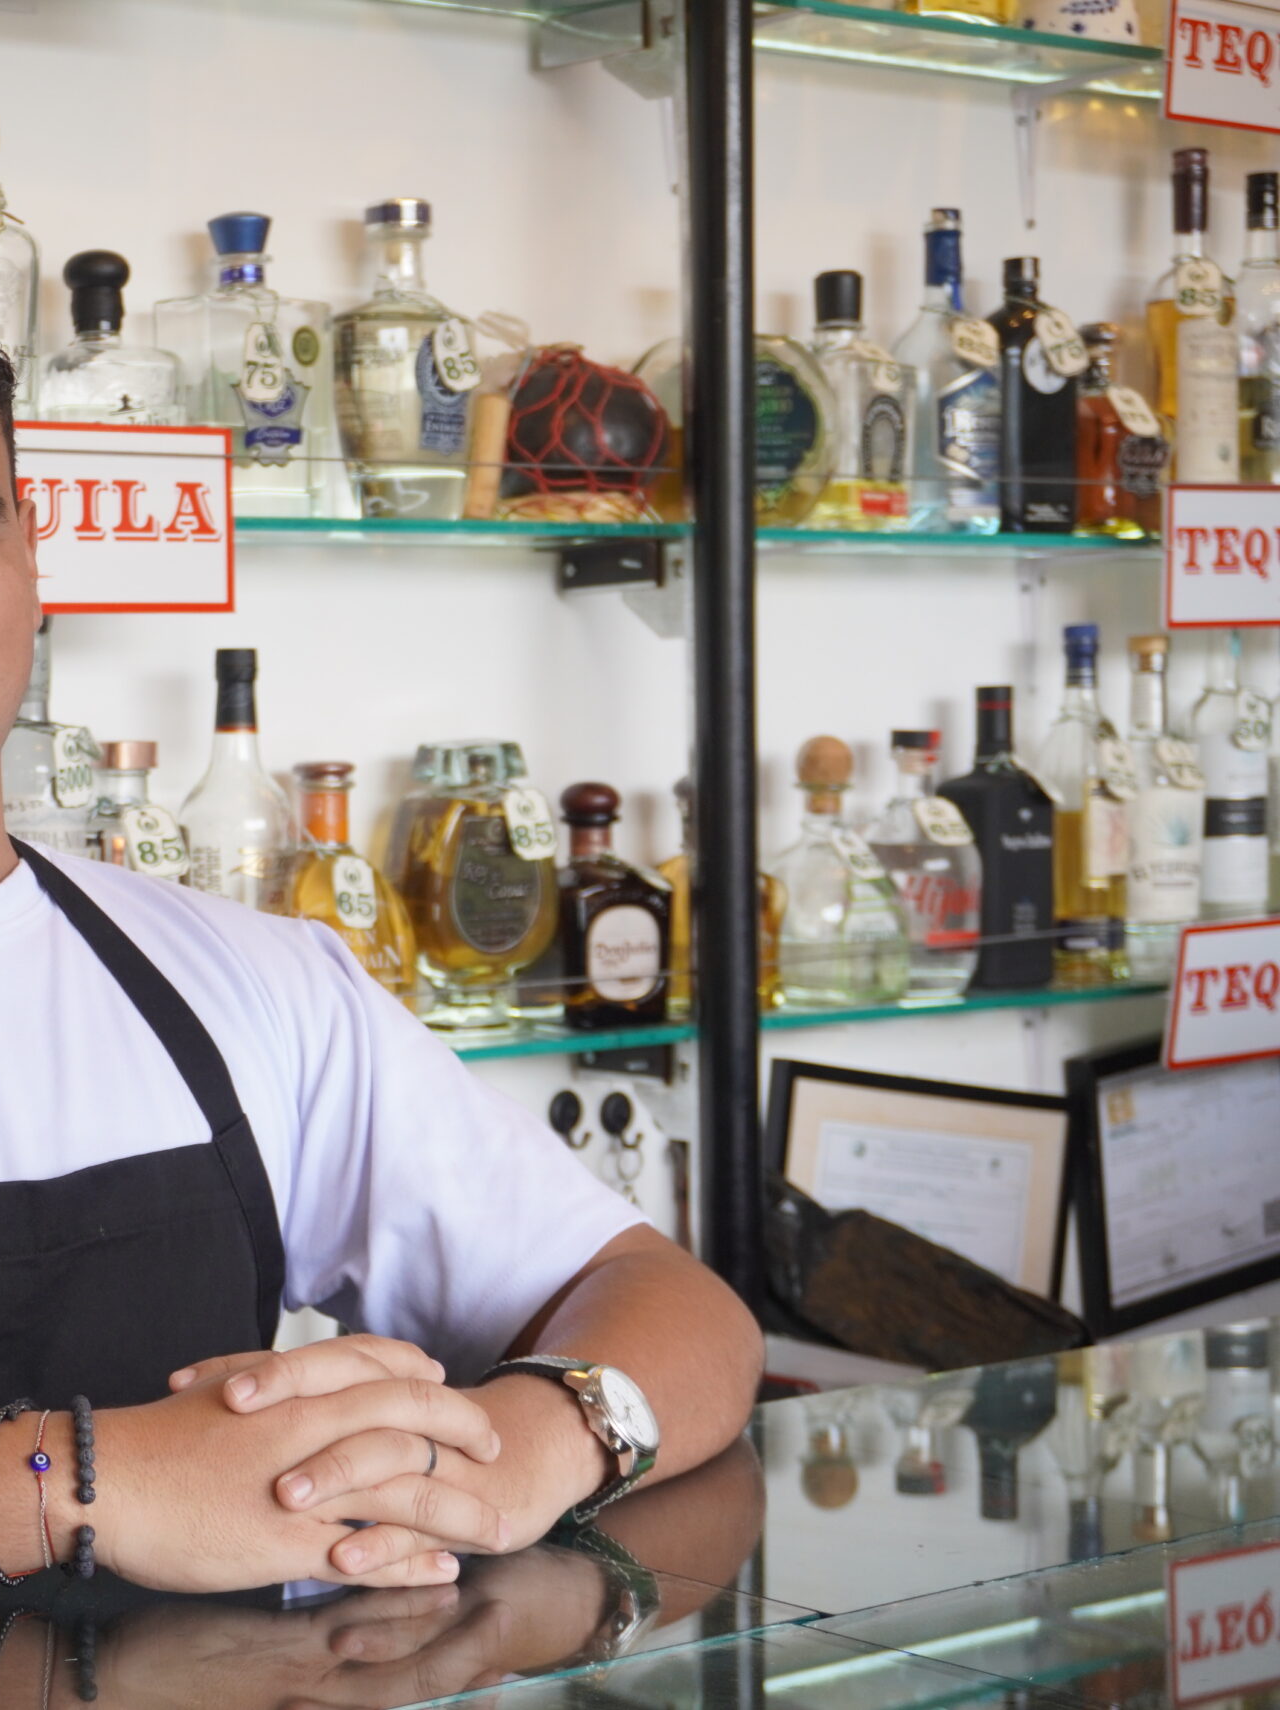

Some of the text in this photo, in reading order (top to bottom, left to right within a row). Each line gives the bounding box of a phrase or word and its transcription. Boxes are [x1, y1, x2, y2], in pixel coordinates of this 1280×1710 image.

[1179, 17, 1280, 88] TEQ
[246, 360, 278, 389] 75
[442, 352, 478, 381] 85
[1177, 527, 1280, 582] TEQ
[514, 822, 554, 848] 85
[137, 838, 185, 867] 85
[1180, 1589, 1280, 1665] LEÓ
